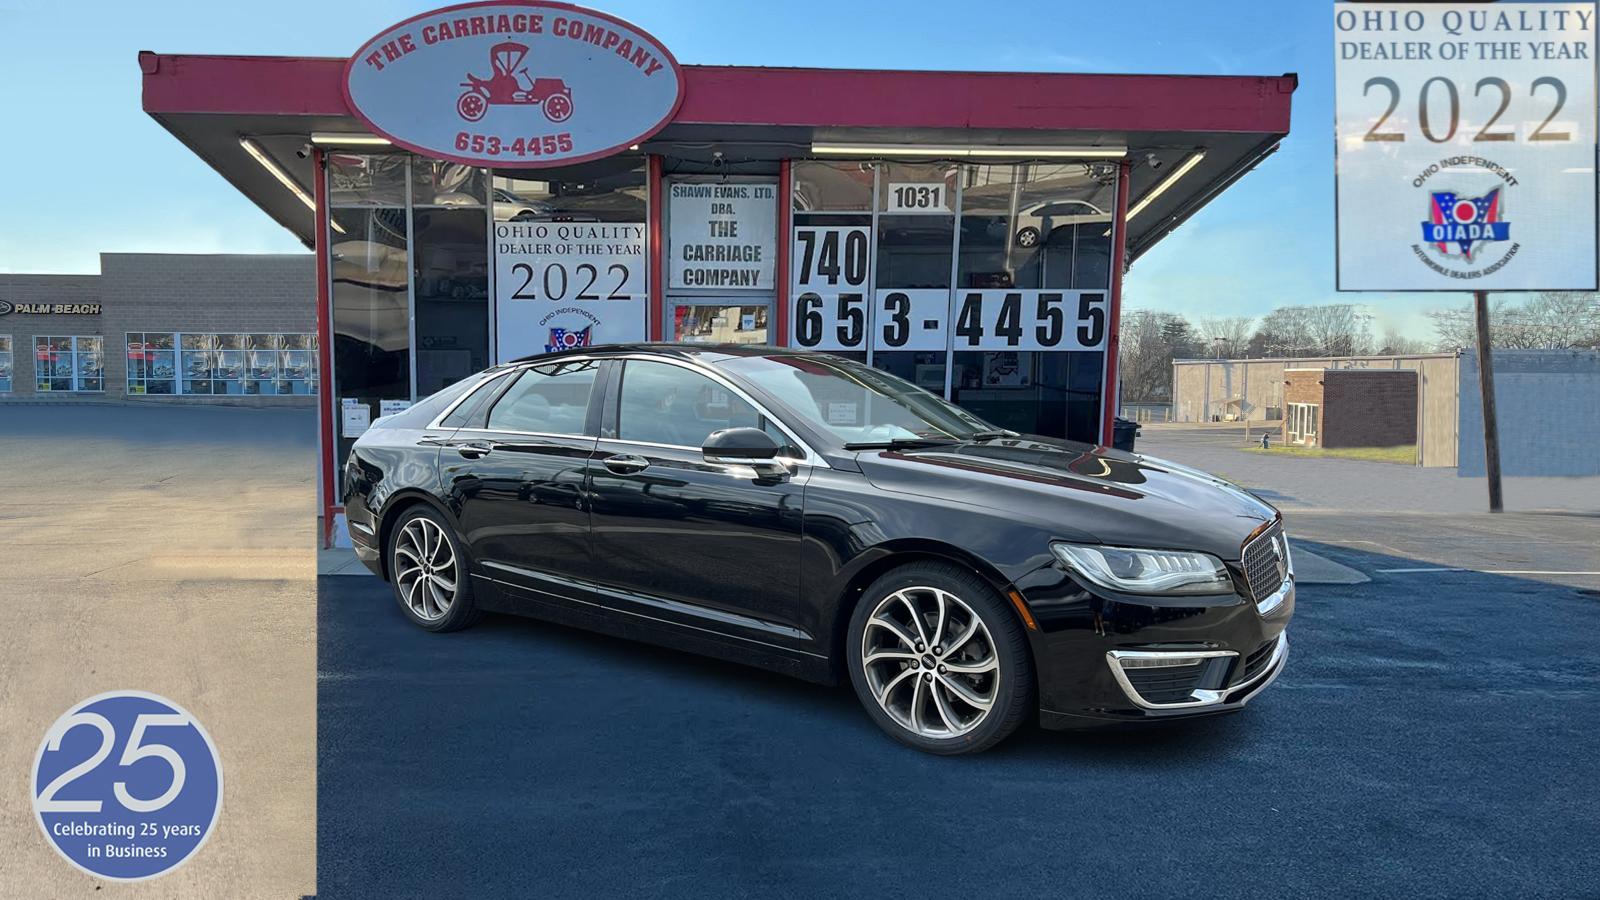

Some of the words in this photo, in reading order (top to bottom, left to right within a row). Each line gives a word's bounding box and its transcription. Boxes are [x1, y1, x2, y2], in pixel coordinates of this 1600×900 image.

[1336, 10, 1425, 32] OHIO
[1441, 10, 1593, 36] QUALITY
[365, 33, 416, 72] THE
[422, 14, 544, 46] CARRIAGE
[552, 17, 664, 77] COMPANY
[1340, 42, 1433, 60] DEALER
[1438, 42, 1470, 60] OF
[1474, 42, 1522, 60] THE
[1527, 42, 1590, 60] YEAR
[1362, 76, 1571, 143] 2022
[455, 132, 573, 156] 653-4455
[1412, 164, 1439, 188] OHIO
[1440, 156, 1519, 187] INDEPENDENT
[672, 186, 712, 199] SHAWN
[754, 187, 775, 199] LTD.
[894, 186, 941, 208] 1031
[711, 203, 736, 215] DBA.
[497, 225, 548, 239] OHIO
[557, 226, 644, 241] QUALITY
[708, 220, 738, 238] THE
[1432, 224, 1495, 241] OIADA
[500, 244, 552, 255] DEALER
[555, 244, 574, 255] OF
[576, 244, 603, 255] THE
[605, 244, 641, 255] YEAR
[683, 244, 762, 262] CARRIAGE
[797, 229, 868, 286] 740
[1411, 244, 1449, 277] AUTOMOBILE
[1449, 270, 1482, 280] DEALERS
[1482, 242, 1521, 276] ASSOCIATION
[511, 263, 632, 301] 2022
[683, 268, 761, 286] COMPANY
[14, 303, 51, 314] PALM
[55, 304, 100, 314] BEACH
[539, 311, 555, 326] OHIO
[555, 307, 601, 326] INDEPENDENT
